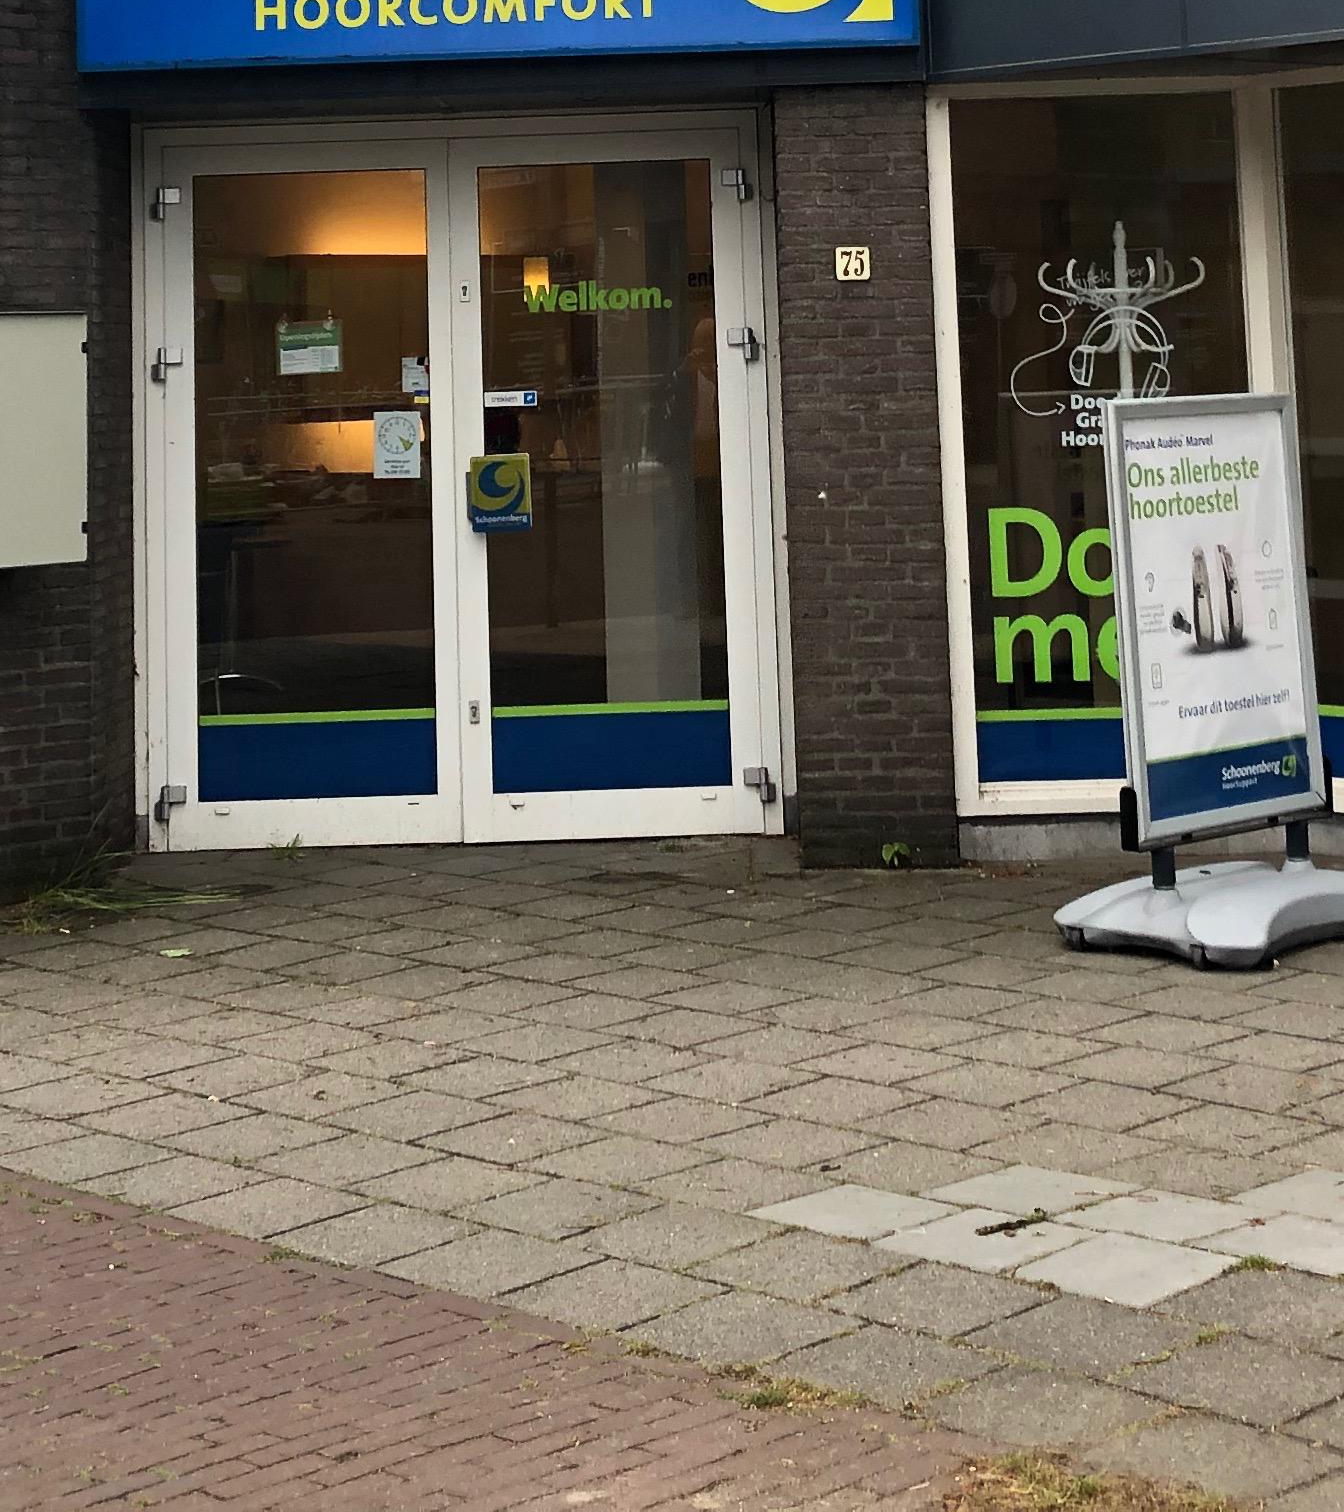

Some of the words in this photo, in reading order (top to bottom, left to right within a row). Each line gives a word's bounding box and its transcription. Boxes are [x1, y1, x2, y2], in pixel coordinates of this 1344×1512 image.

[840, 250, 865, 276] 75
[524, 280, 673, 313] Welkom.
[1125, 438, 1156, 451] Phonak
[1186, 434, 1213, 447] Marvel
[1127, 462, 1165, 488] Ons
[1170, 455, 1260, 485] allerbeste
[1129, 484, 1239, 520] hoortoestel
[1178, 704, 1208, 719] Ervaar
[1210, 700, 1223, 714] dit
[1224, 694, 1255, 712] toestel
[1256, 693, 1271, 706] hier
[1221, 759, 1281, 780] Schoonenberg
